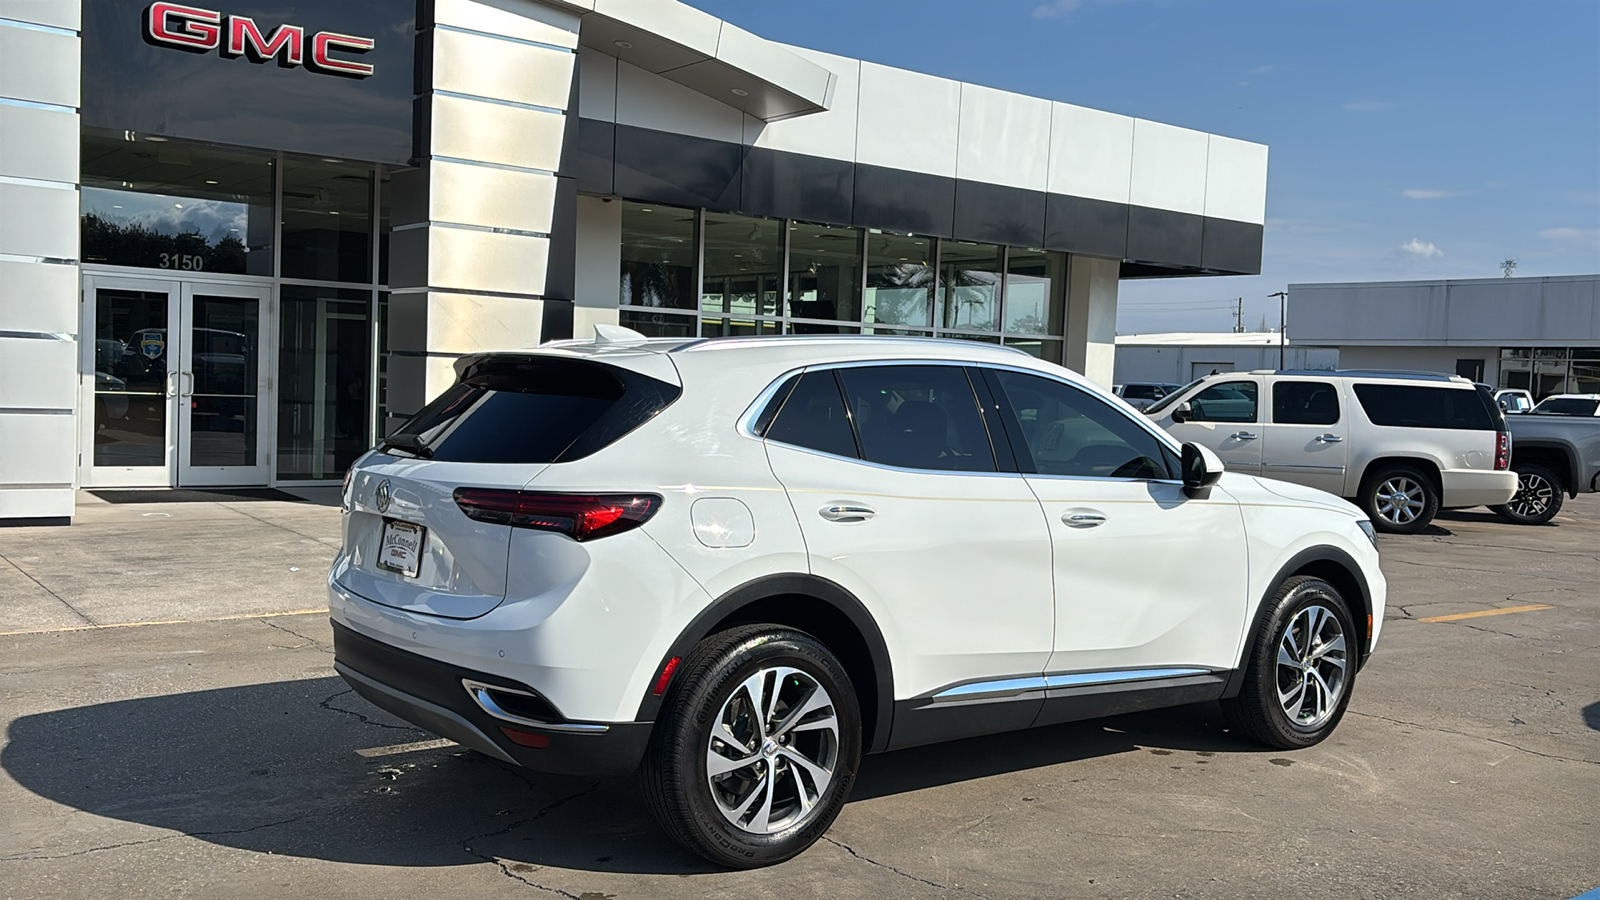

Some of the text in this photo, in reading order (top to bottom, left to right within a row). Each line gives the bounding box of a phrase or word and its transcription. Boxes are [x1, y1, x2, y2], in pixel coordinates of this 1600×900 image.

[147, 1, 375, 76] GMC
[159, 252, 204, 271] 3150
[386, 533, 418, 553] McConnell
[390, 549, 407, 560] GMC
